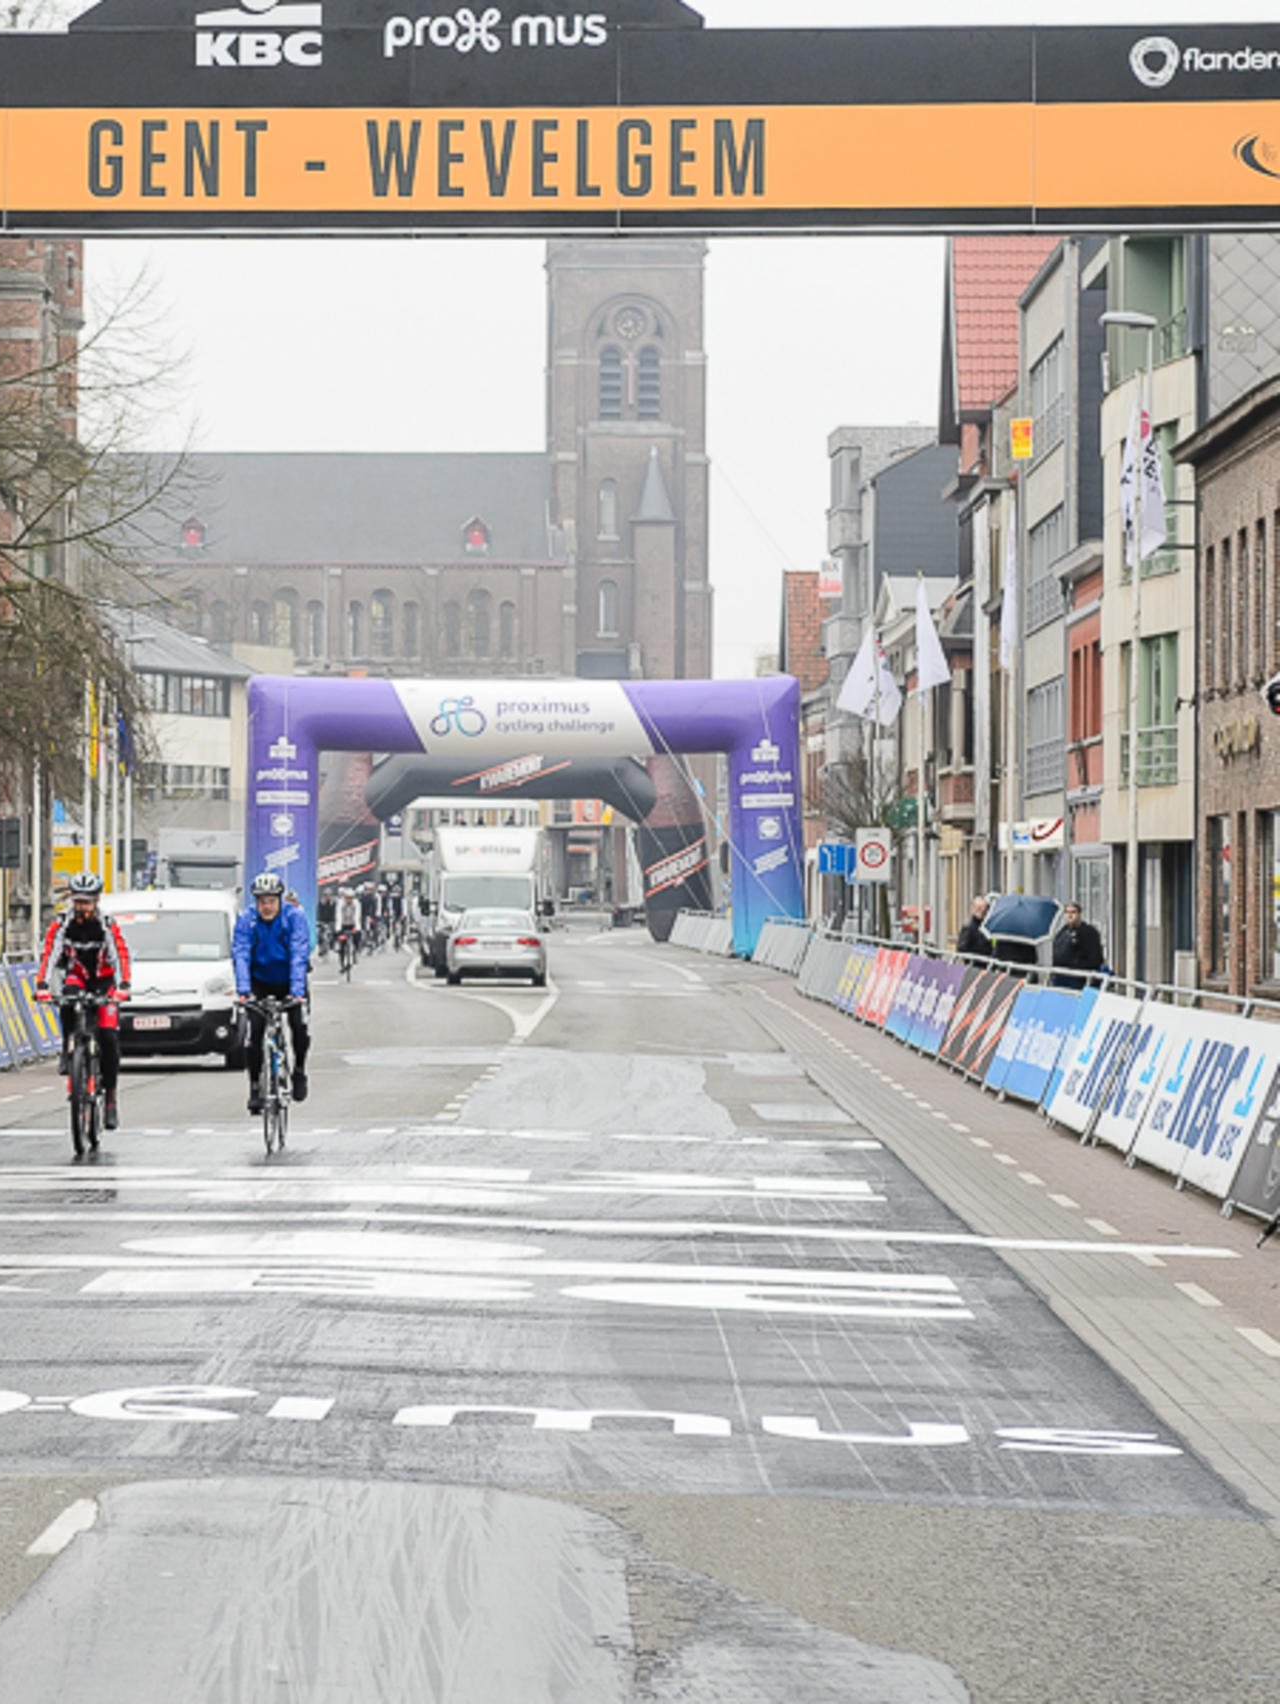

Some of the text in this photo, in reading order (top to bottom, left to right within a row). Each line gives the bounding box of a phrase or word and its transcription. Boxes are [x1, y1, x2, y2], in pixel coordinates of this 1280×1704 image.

[195, 31, 322, 66] KBC
[1183, 46, 1280, 71] flander
[87, 119, 269, 198] GENT
[365, 118, 766, 198] WEVELGEM
[496, 698, 591, 717] proximus
[546, 719, 616, 735] challenge
[1166, 1038, 1251, 1156] KBC
